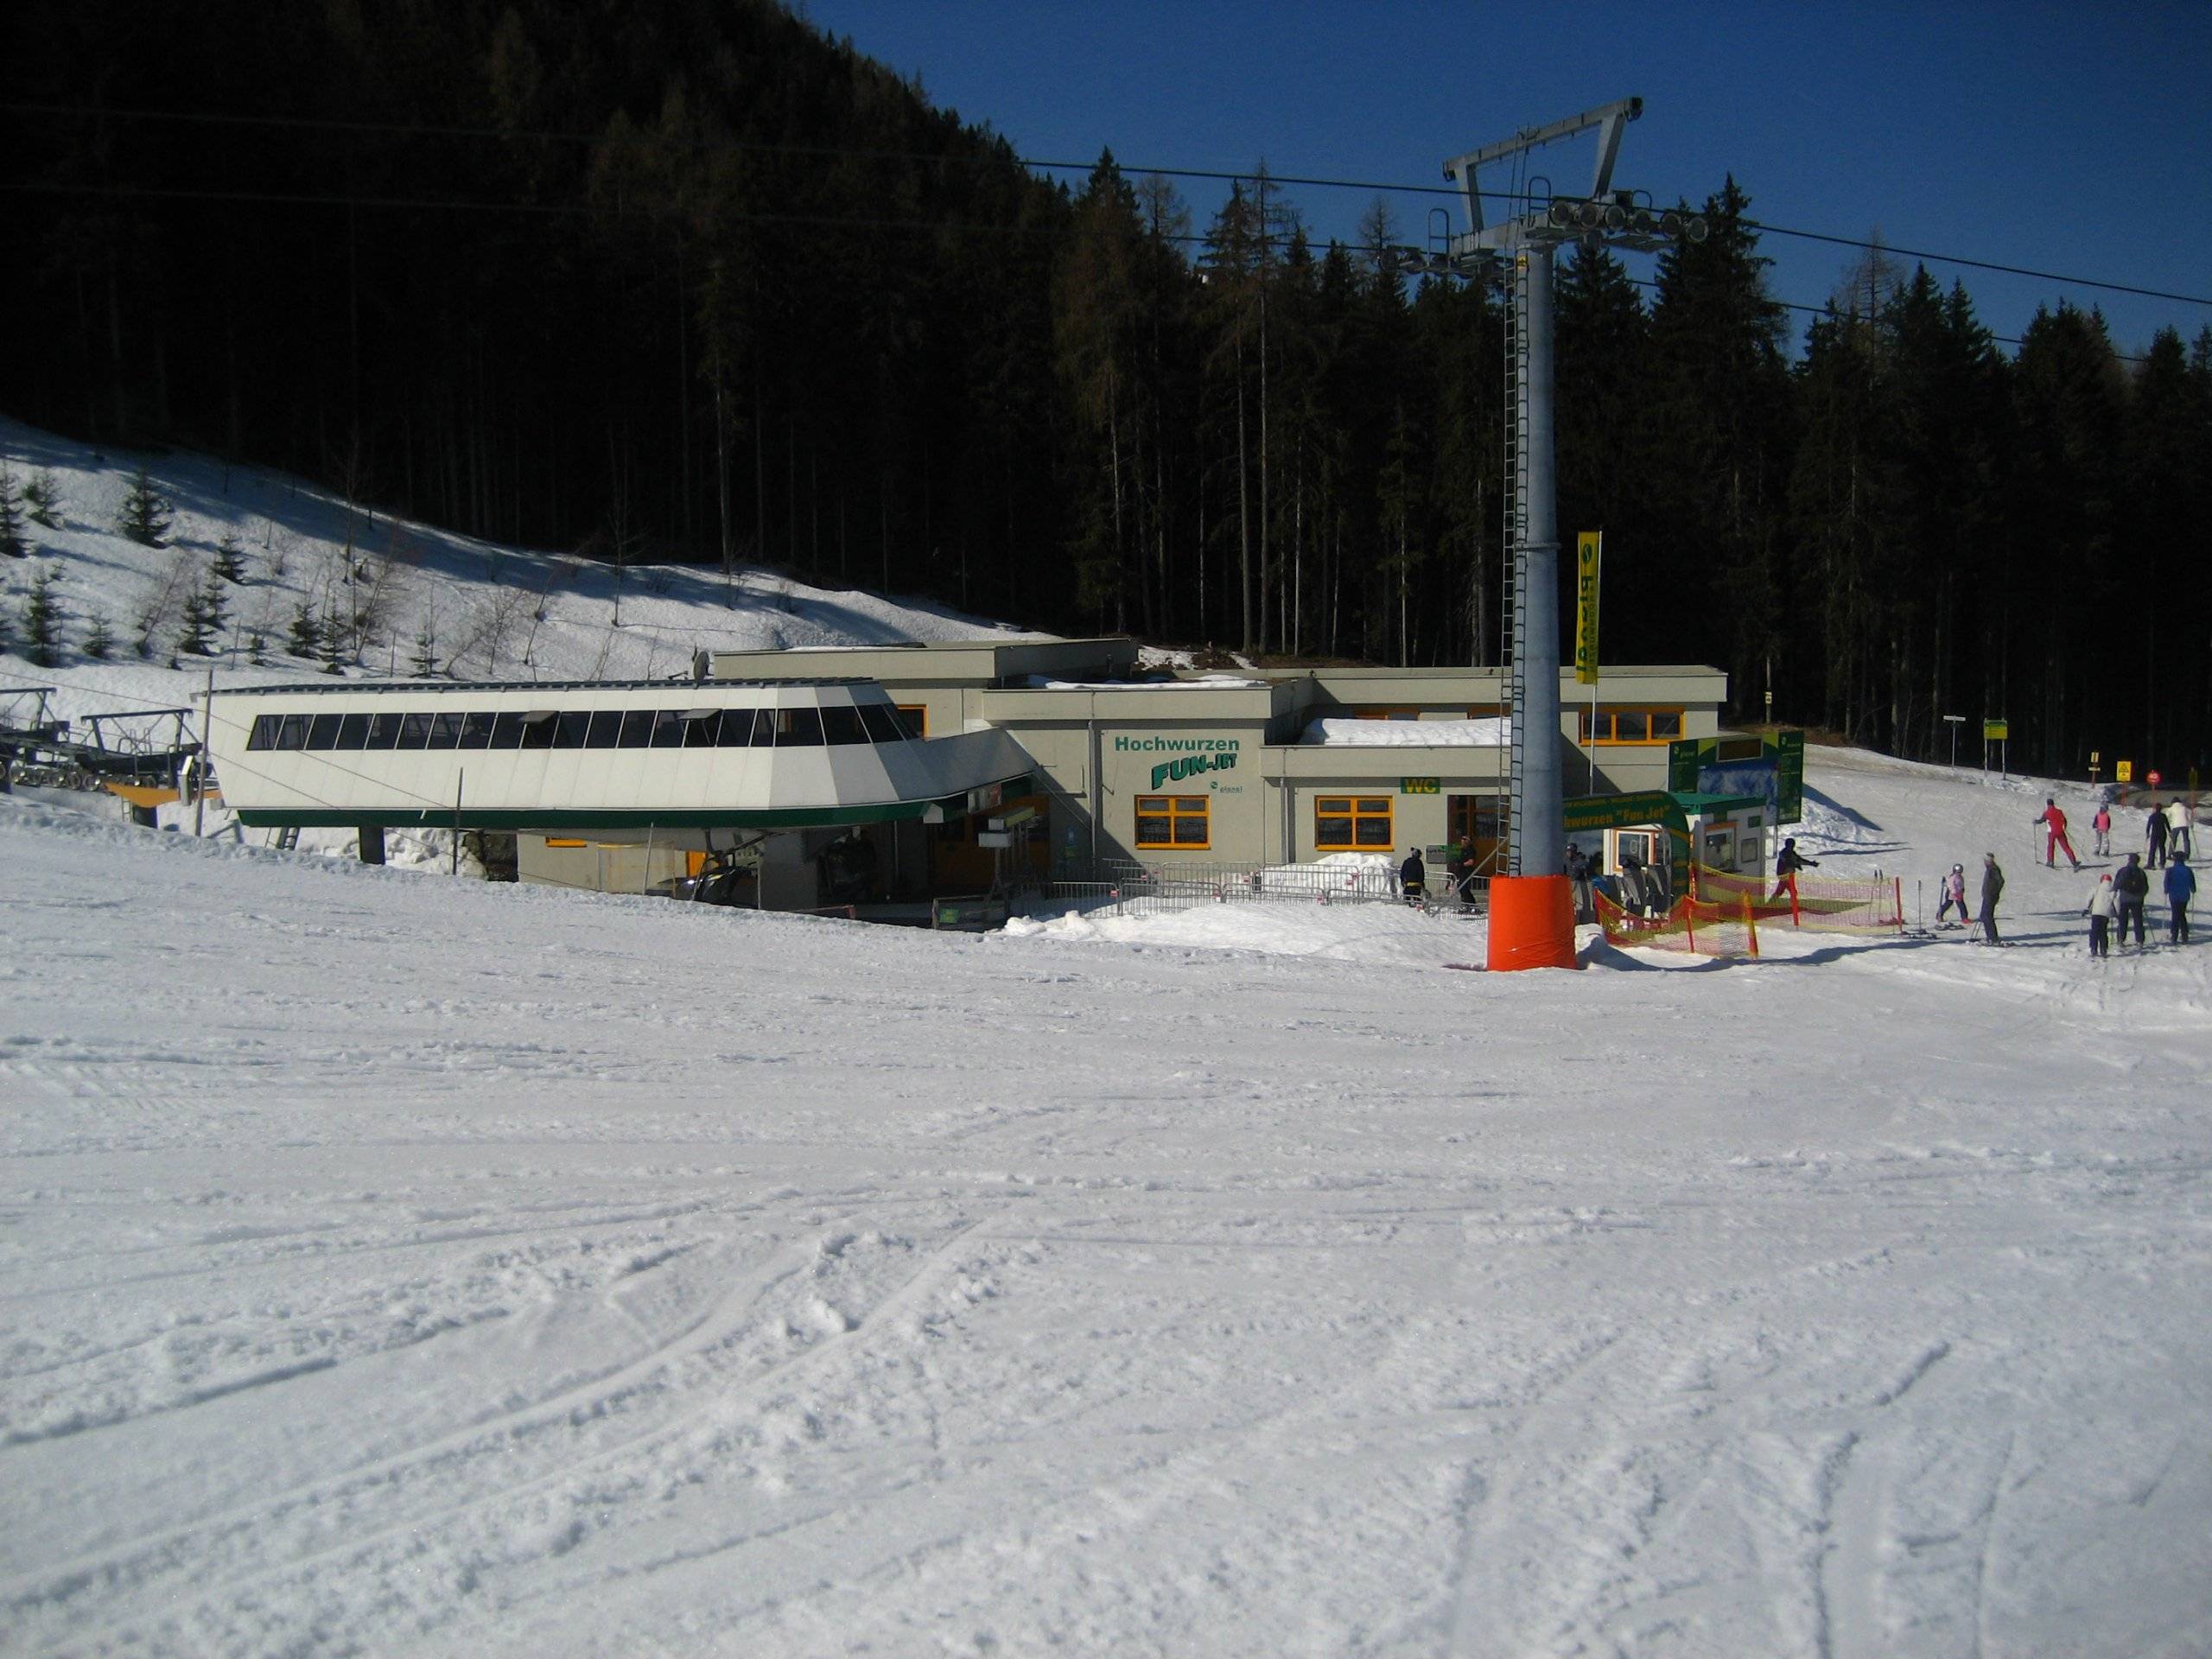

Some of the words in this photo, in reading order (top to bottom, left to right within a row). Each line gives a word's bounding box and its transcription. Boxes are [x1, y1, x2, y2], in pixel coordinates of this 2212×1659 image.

[1116, 736, 1240, 751] Hochwurzen
[1151, 753, 1238, 791] FUN-JET
[1406, 778, 1437, 794] WC
